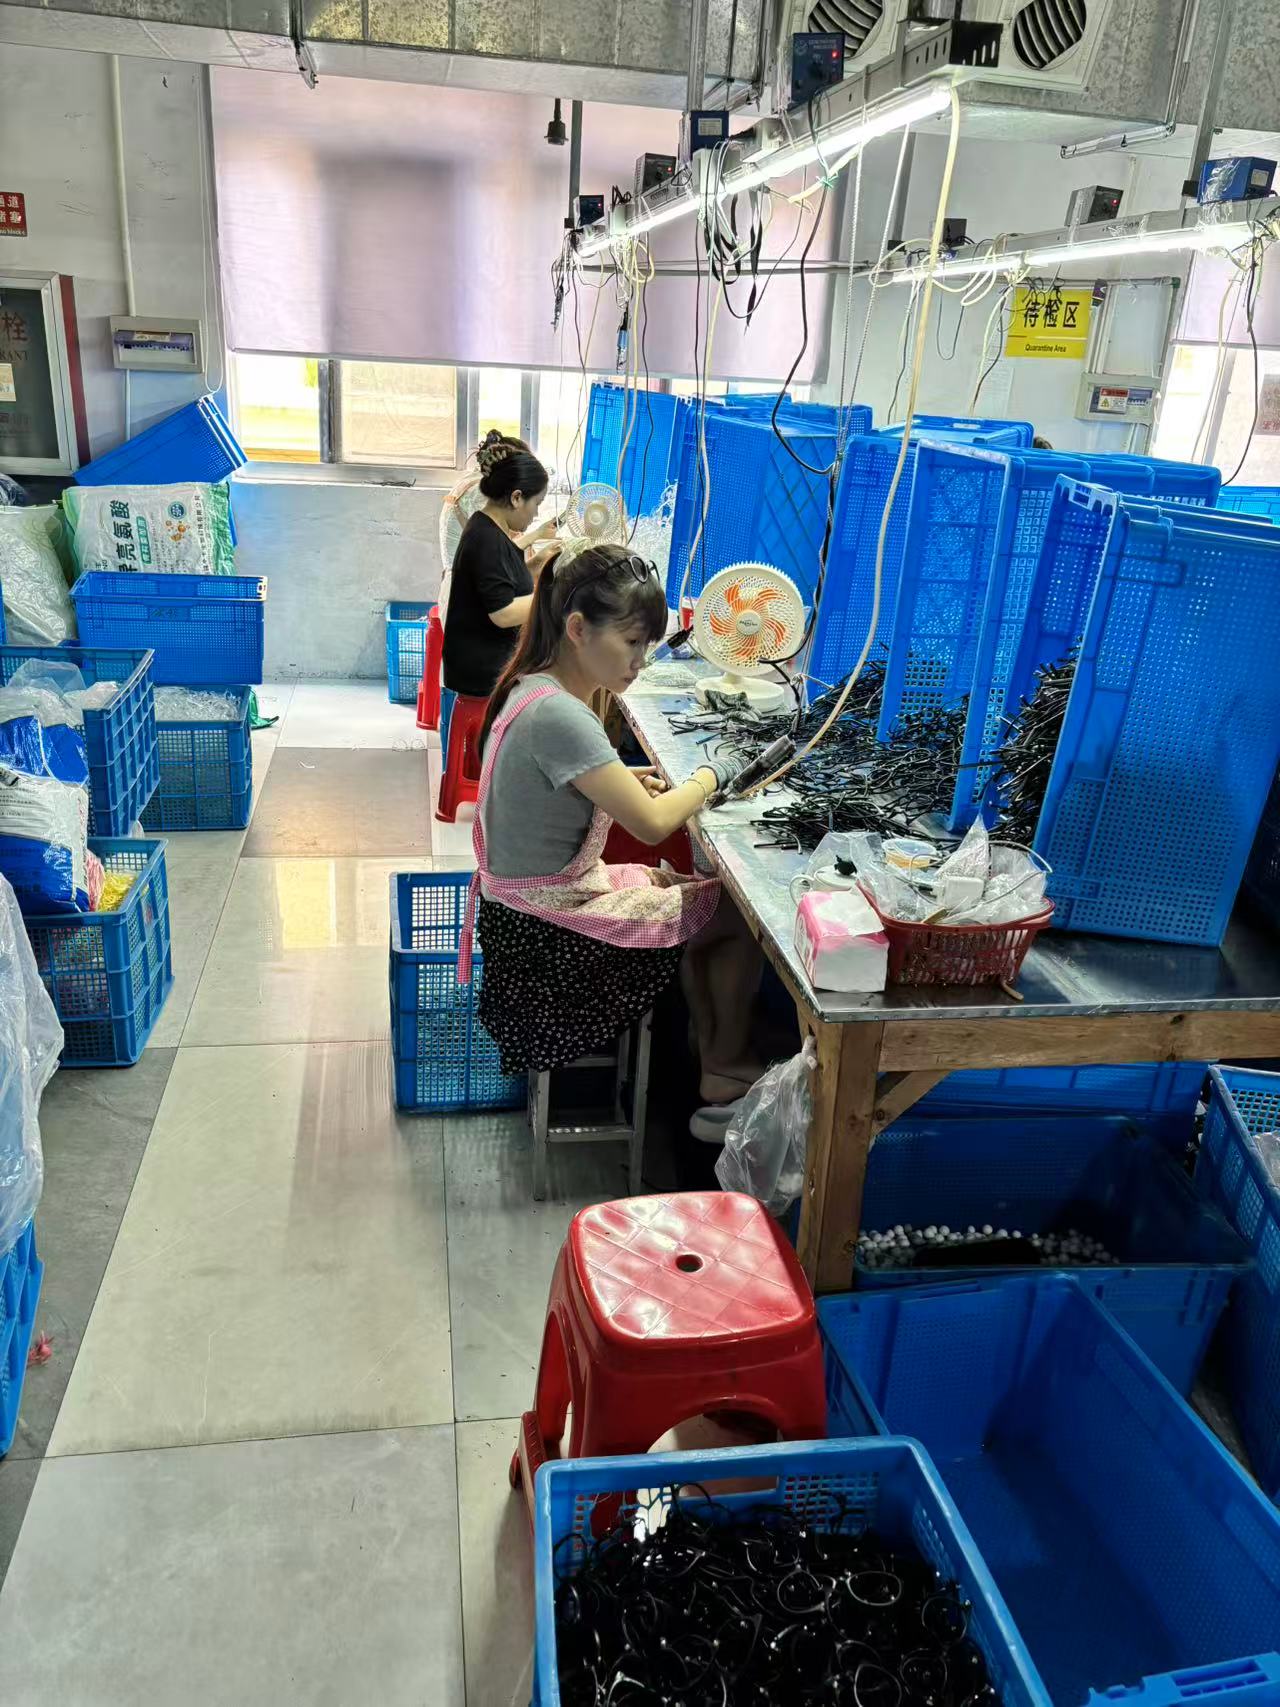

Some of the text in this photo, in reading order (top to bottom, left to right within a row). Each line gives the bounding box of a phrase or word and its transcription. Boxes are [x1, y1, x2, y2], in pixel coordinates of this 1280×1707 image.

[1024, 299, 1080, 328] 待检区
[1025, 343, 1067, 353] Quarantine Area
